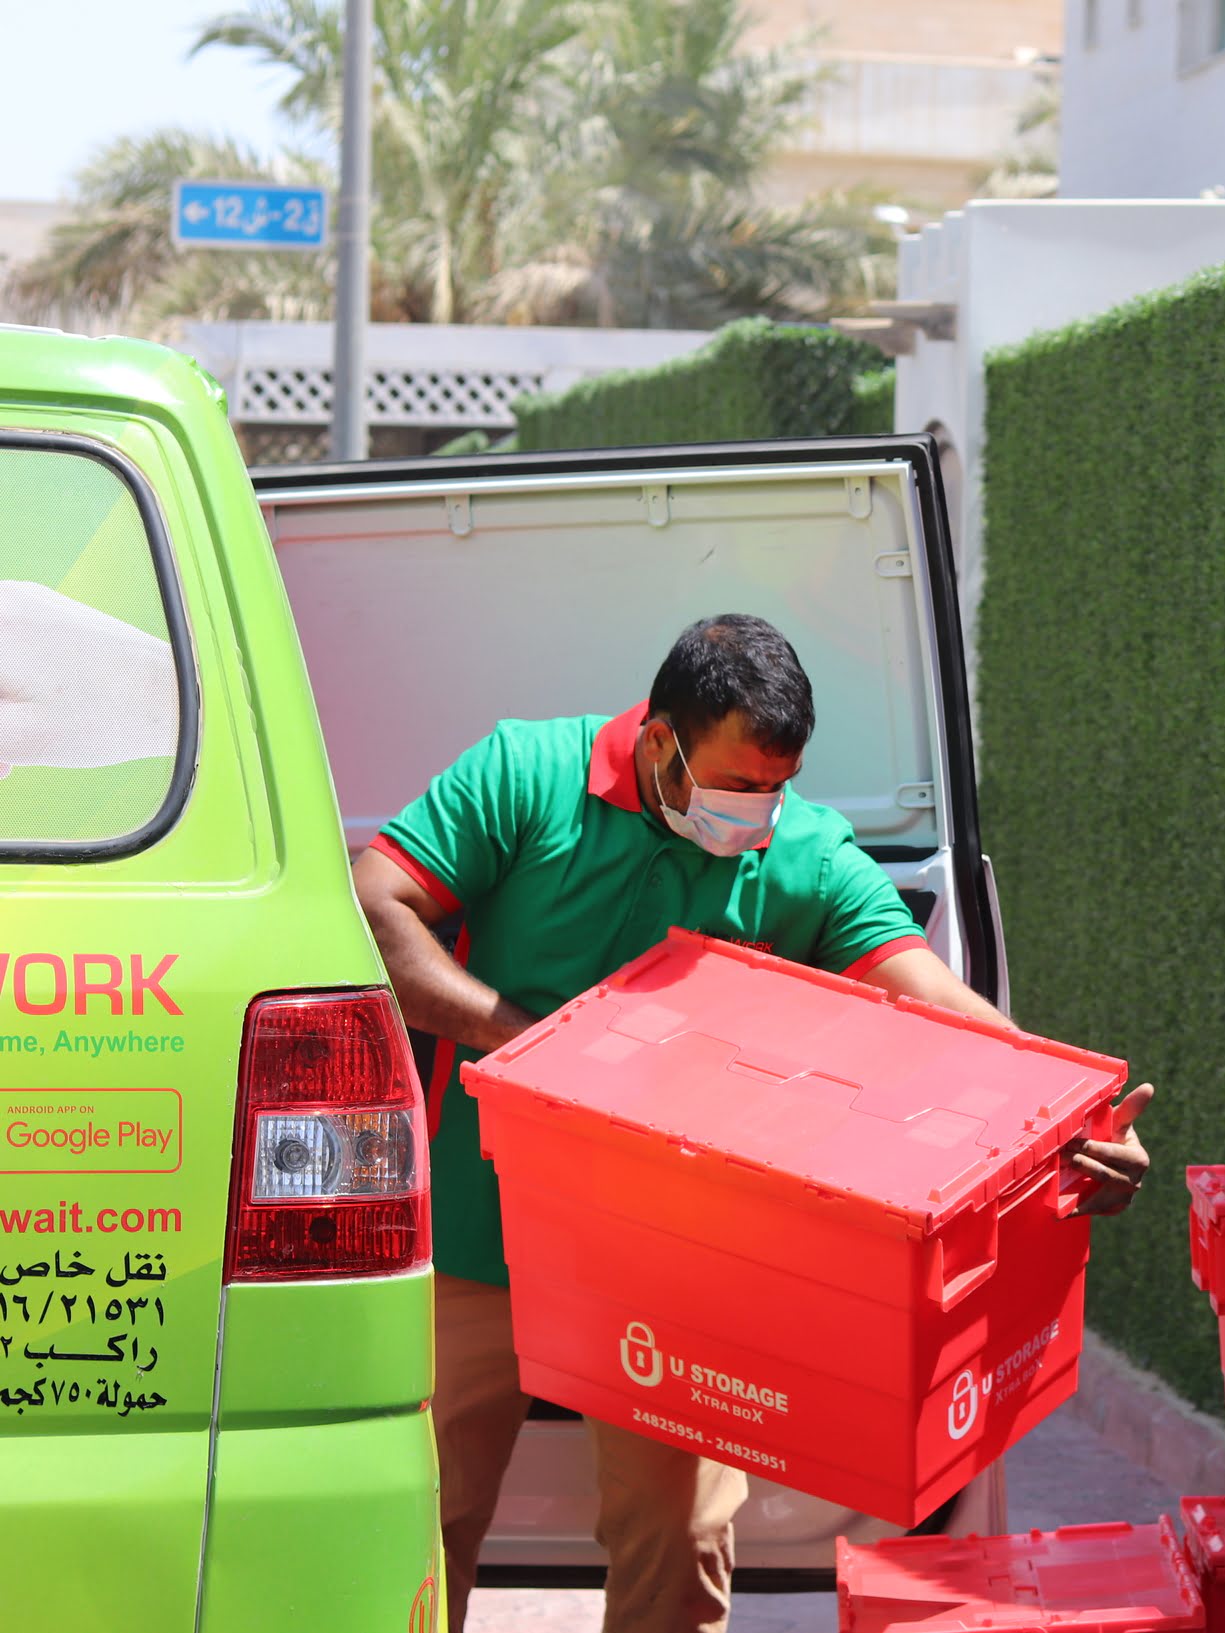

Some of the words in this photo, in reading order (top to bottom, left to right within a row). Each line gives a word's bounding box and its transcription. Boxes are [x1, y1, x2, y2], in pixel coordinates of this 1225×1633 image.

[53, 1030, 185, 1057] Anywhere
[7, 1105, 54, 1114] ANDROID
[57, 1105, 77, 1114] APP
[79, 1105, 94, 1114] ON
[6, 1121, 110, 1154] Google
[118, 1121, 173, 1154] Play
[0, 1250, 96, 1285] خاص
[105, 1251, 167, 1287] نقل
[23, 1333, 158, 1371] راكب
[981, 1372, 993, 1395] U
[996, 1317, 1059, 1384] STORAGE
[96, 1378, 168, 1417] حمولة
[669, 1355, 684, 1376] U
[690, 1363, 789, 1413] STORAGE
[690, 1387, 729, 1414] XTRA
[632, 1407, 704, 1444] 24825954
[715, 1437, 787, 1472] 24825951
